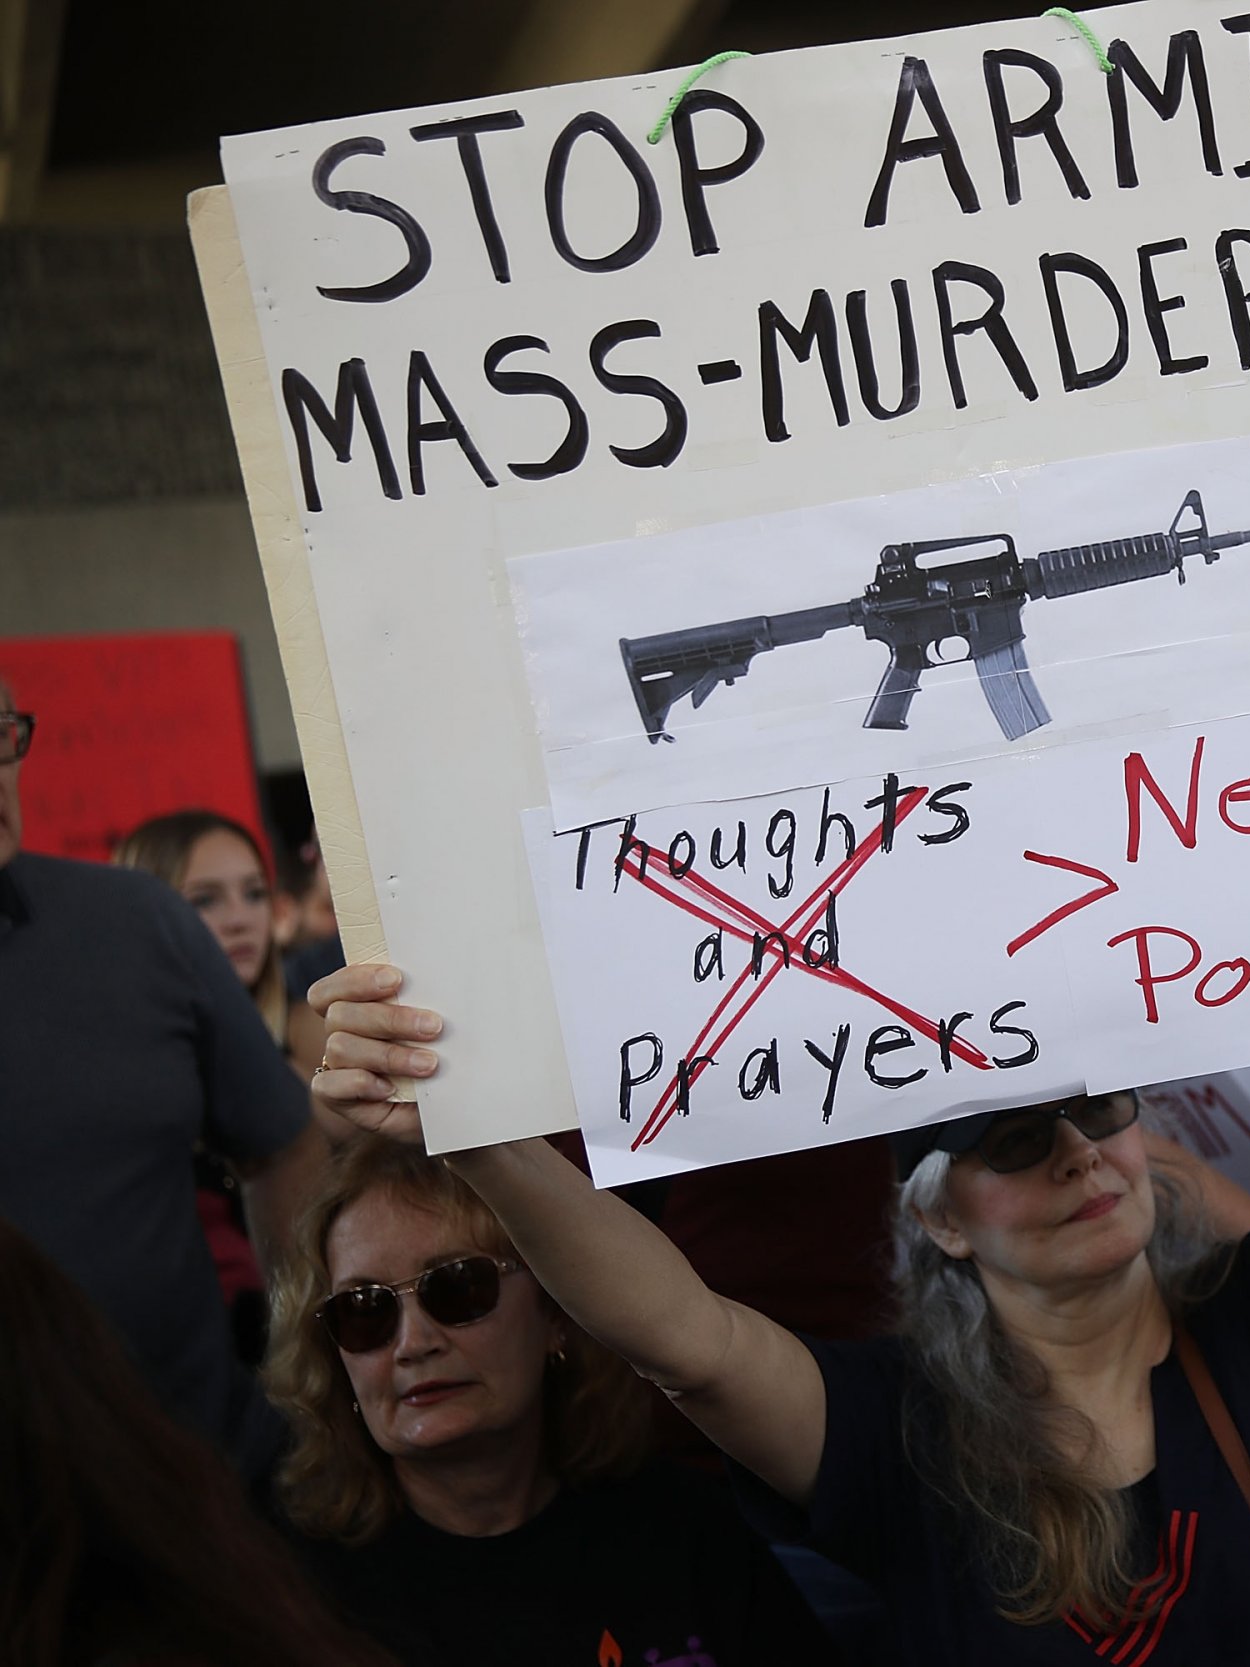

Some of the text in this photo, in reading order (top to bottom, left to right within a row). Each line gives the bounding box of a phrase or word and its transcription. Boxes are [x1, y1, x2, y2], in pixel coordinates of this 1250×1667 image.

[312, 88, 766, 303] STOP
[553, 772, 973, 893] Thoughts
[693, 889, 840, 983] and
[619, 1000, 1040, 1124] Prayers
